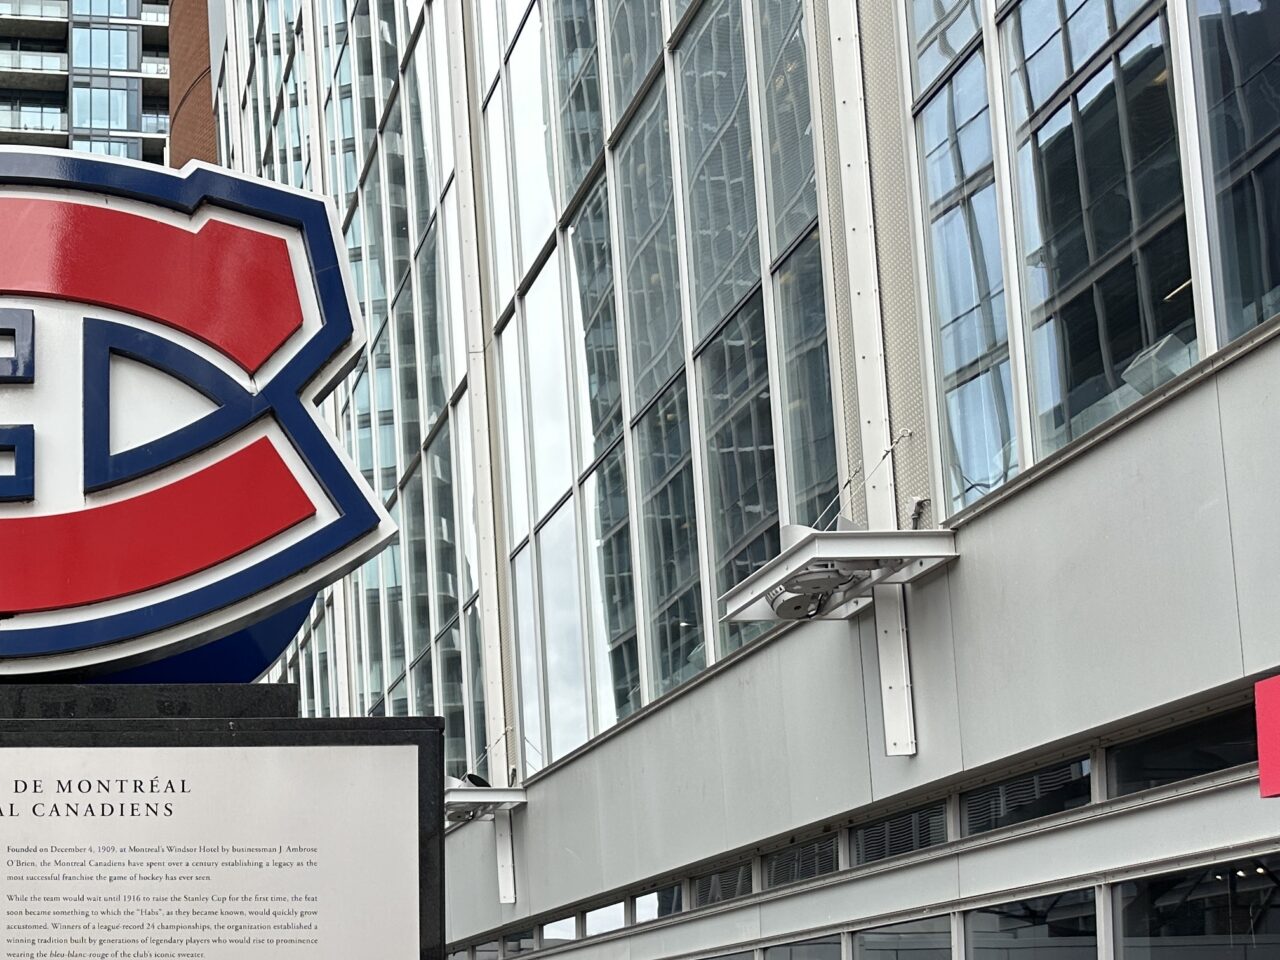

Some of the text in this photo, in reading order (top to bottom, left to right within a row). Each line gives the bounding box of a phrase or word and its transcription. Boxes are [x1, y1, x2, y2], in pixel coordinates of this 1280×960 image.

[13, 779, 44, 793] DE
[56, 776, 192, 793] MONTRÉAL
[32, 802, 174, 817] CANADIENS
[40, 859, 53, 867] the
[54, 859, 87, 867] Montreal
[146, 859, 166, 870] spent
[191, 859, 219, 868] century
[221, 859, 264, 869] establishing
[272, 859, 294, 869] legacy
[43, 894, 61, 903] team
[62, 894, 85, 903] would
[103, 894, 122, 902] until
[143, 894, 151, 902] to
[152, 894, 169, 902] raise
[170, 894, 182, 902] the
[183, 894, 210, 903] Stanley
[211, 895, 227, 904] Cup
[228, 894, 240, 902] for
[254, 894, 269, 902] first
[291, 894, 303, 902] the
[6, 951, 35, 960] wearing
[36, 950, 48, 958] the
[110, 950, 119, 958] of
[120, 950, 132, 958] the
